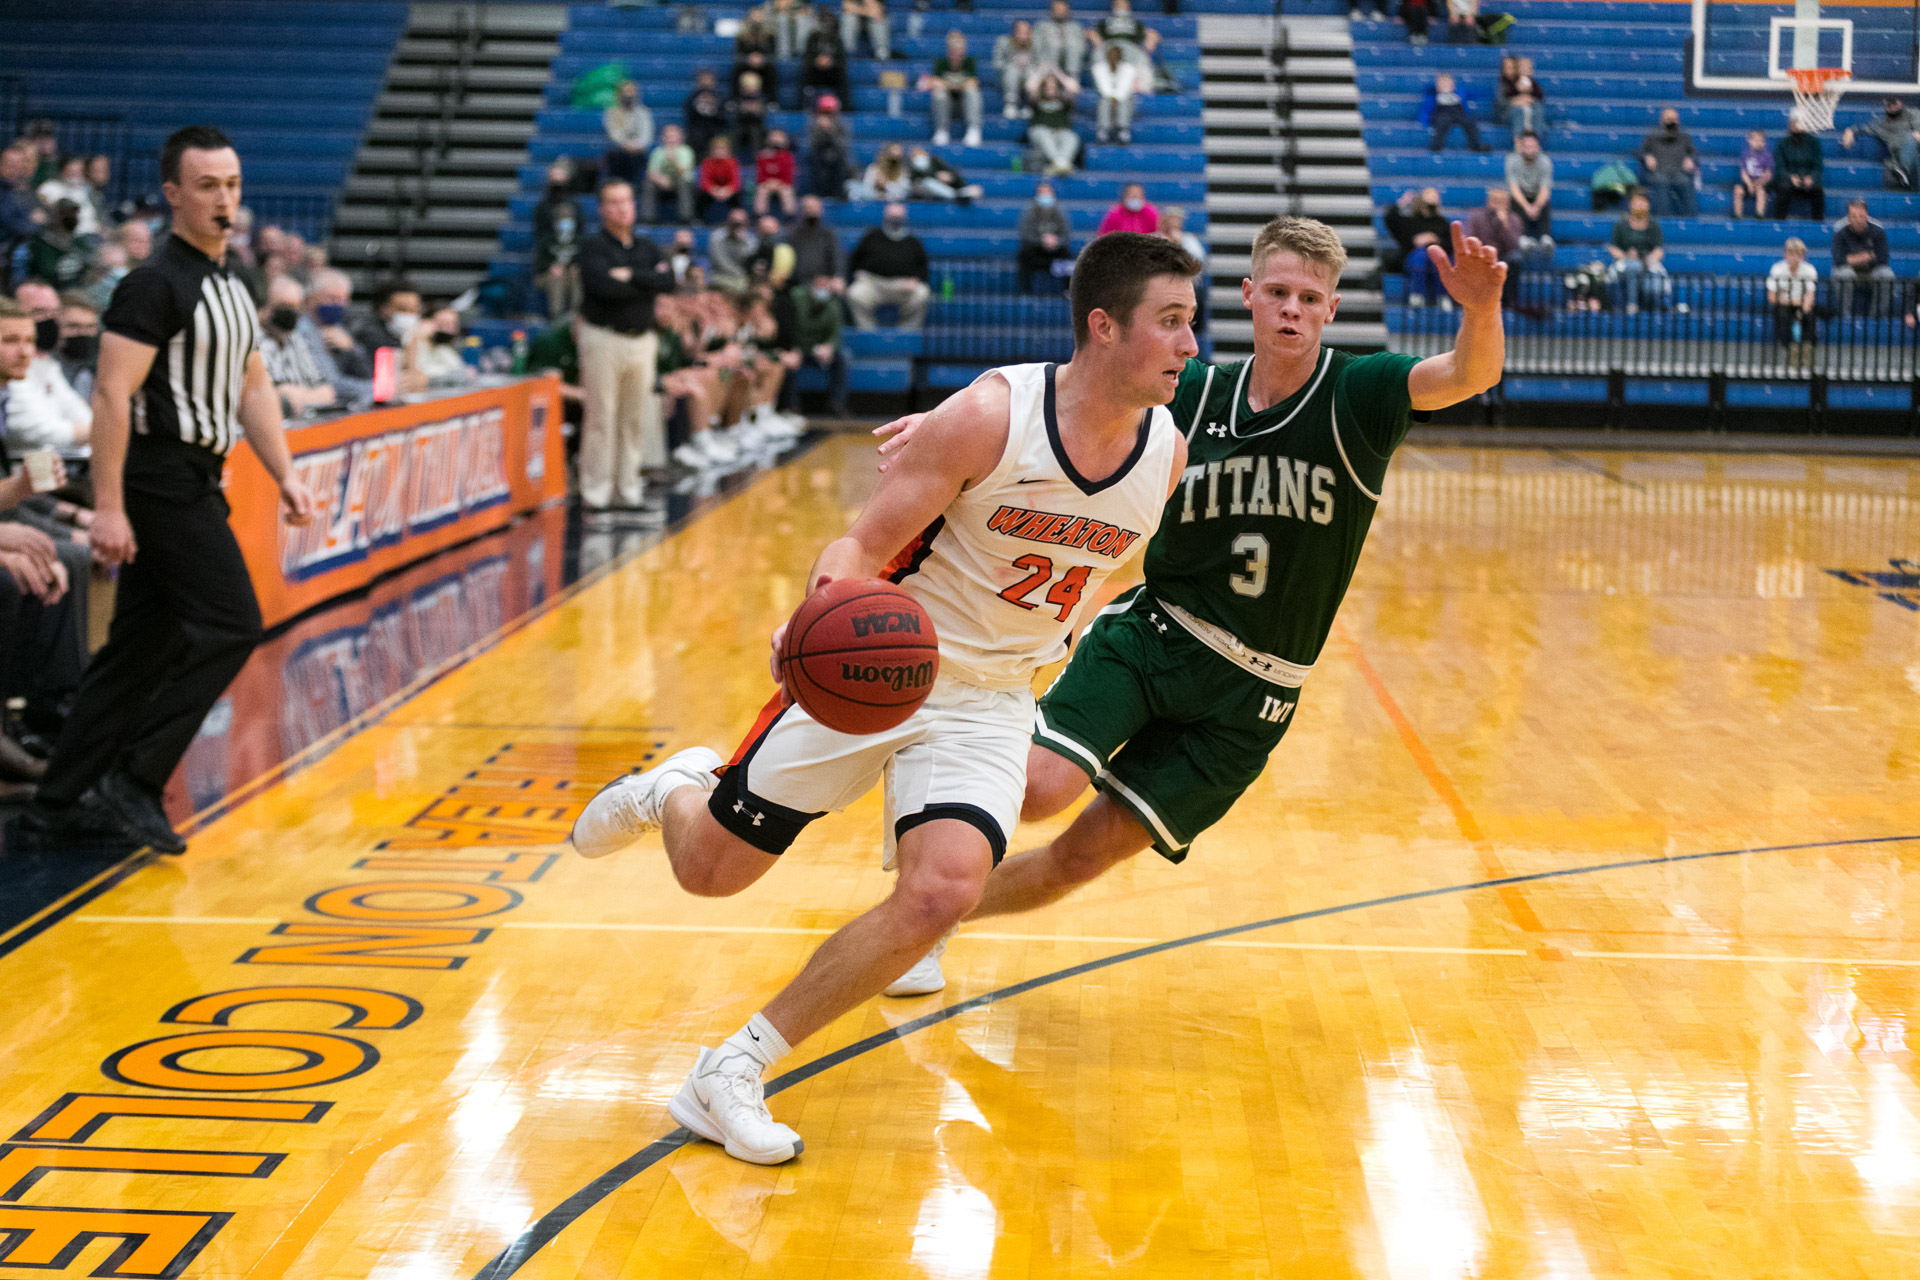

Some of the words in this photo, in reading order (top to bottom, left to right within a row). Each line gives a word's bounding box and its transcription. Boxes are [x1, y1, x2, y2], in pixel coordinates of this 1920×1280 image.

[1180, 455, 1337, 526] TITANS
[987, 505, 1140, 559] WHEATON
[997, 553, 1097, 623] 24
[1229, 532, 1271, 599] 3
[851, 612, 921, 638] NCAA
[842, 660, 934, 692] Wilson
